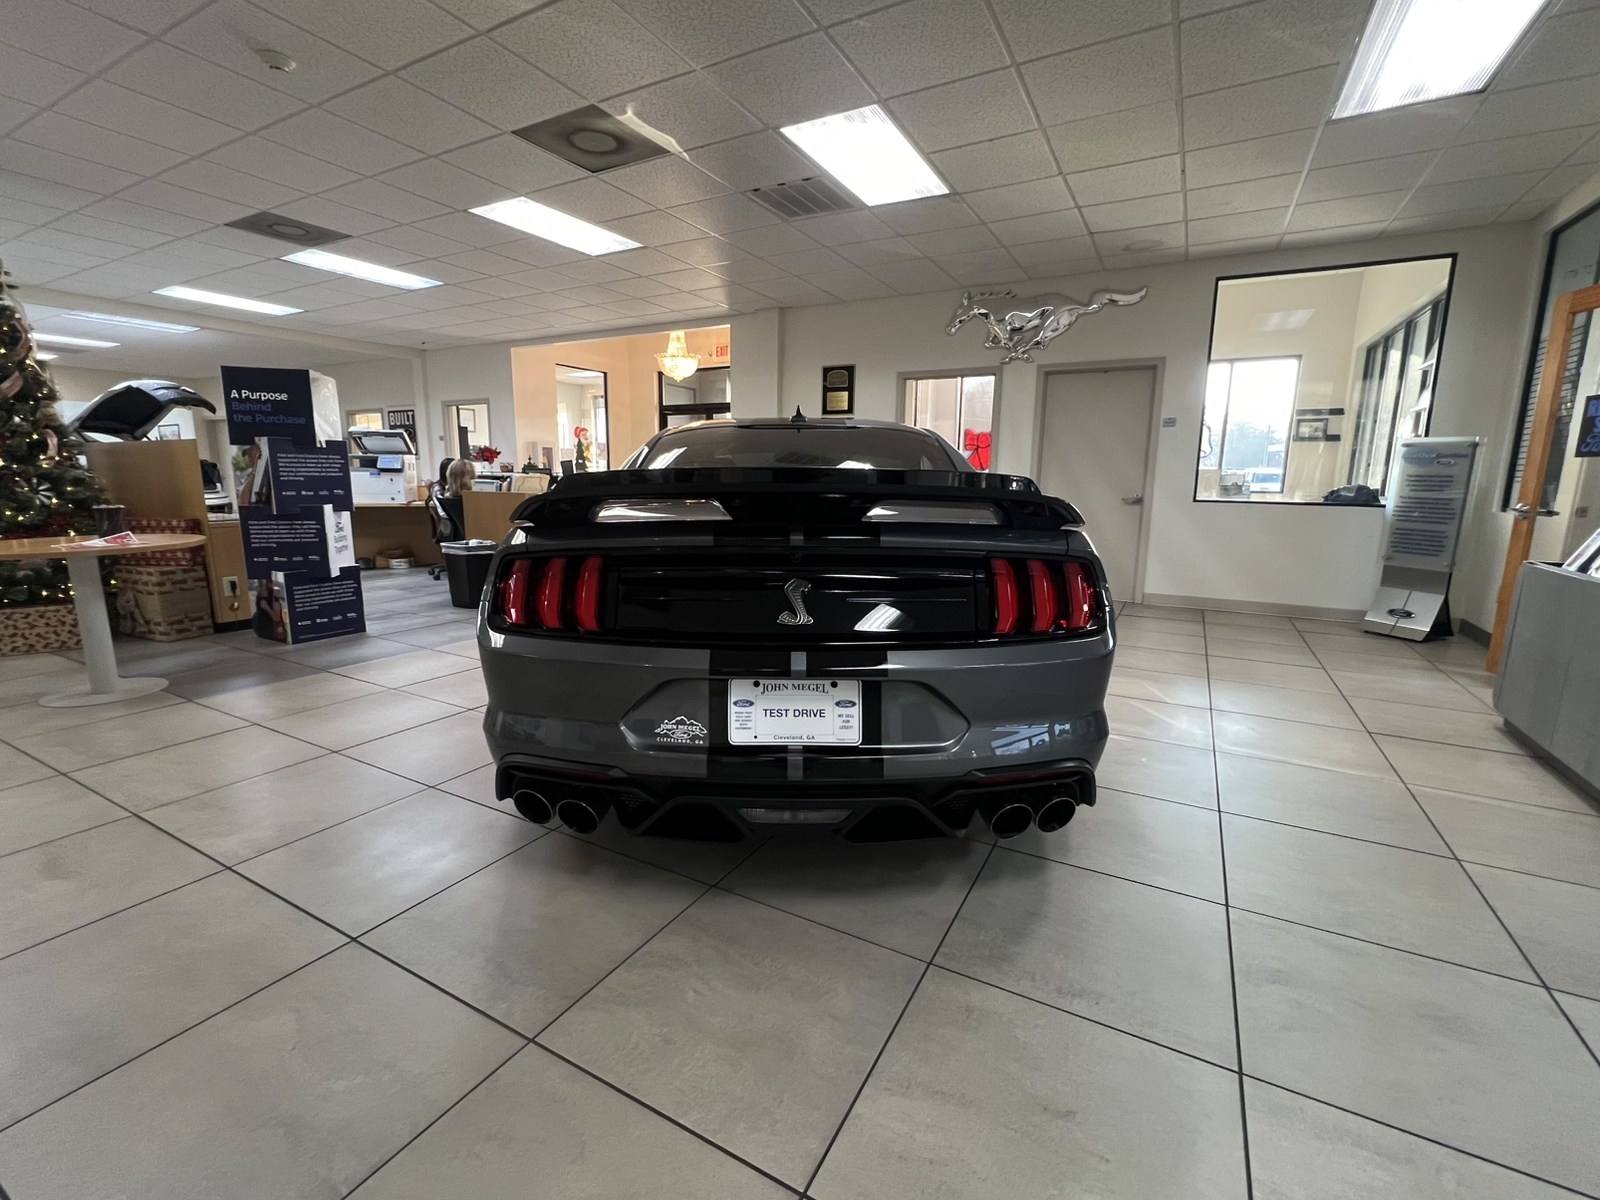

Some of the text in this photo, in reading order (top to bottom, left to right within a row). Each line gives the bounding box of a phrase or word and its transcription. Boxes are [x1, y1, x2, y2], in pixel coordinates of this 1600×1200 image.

[716, 345, 729, 358] EXIT
[230, 389, 288, 402] A Purpose
[231, 401, 272, 412] Behind
[233, 413, 306, 425] the Purchase
[389, 411, 414, 426] BUILT
[760, 683, 829, 695] JOHN MEGEL
[838, 700, 854, 708] Ford
[762, 708, 826, 718] TEST DRIVE
